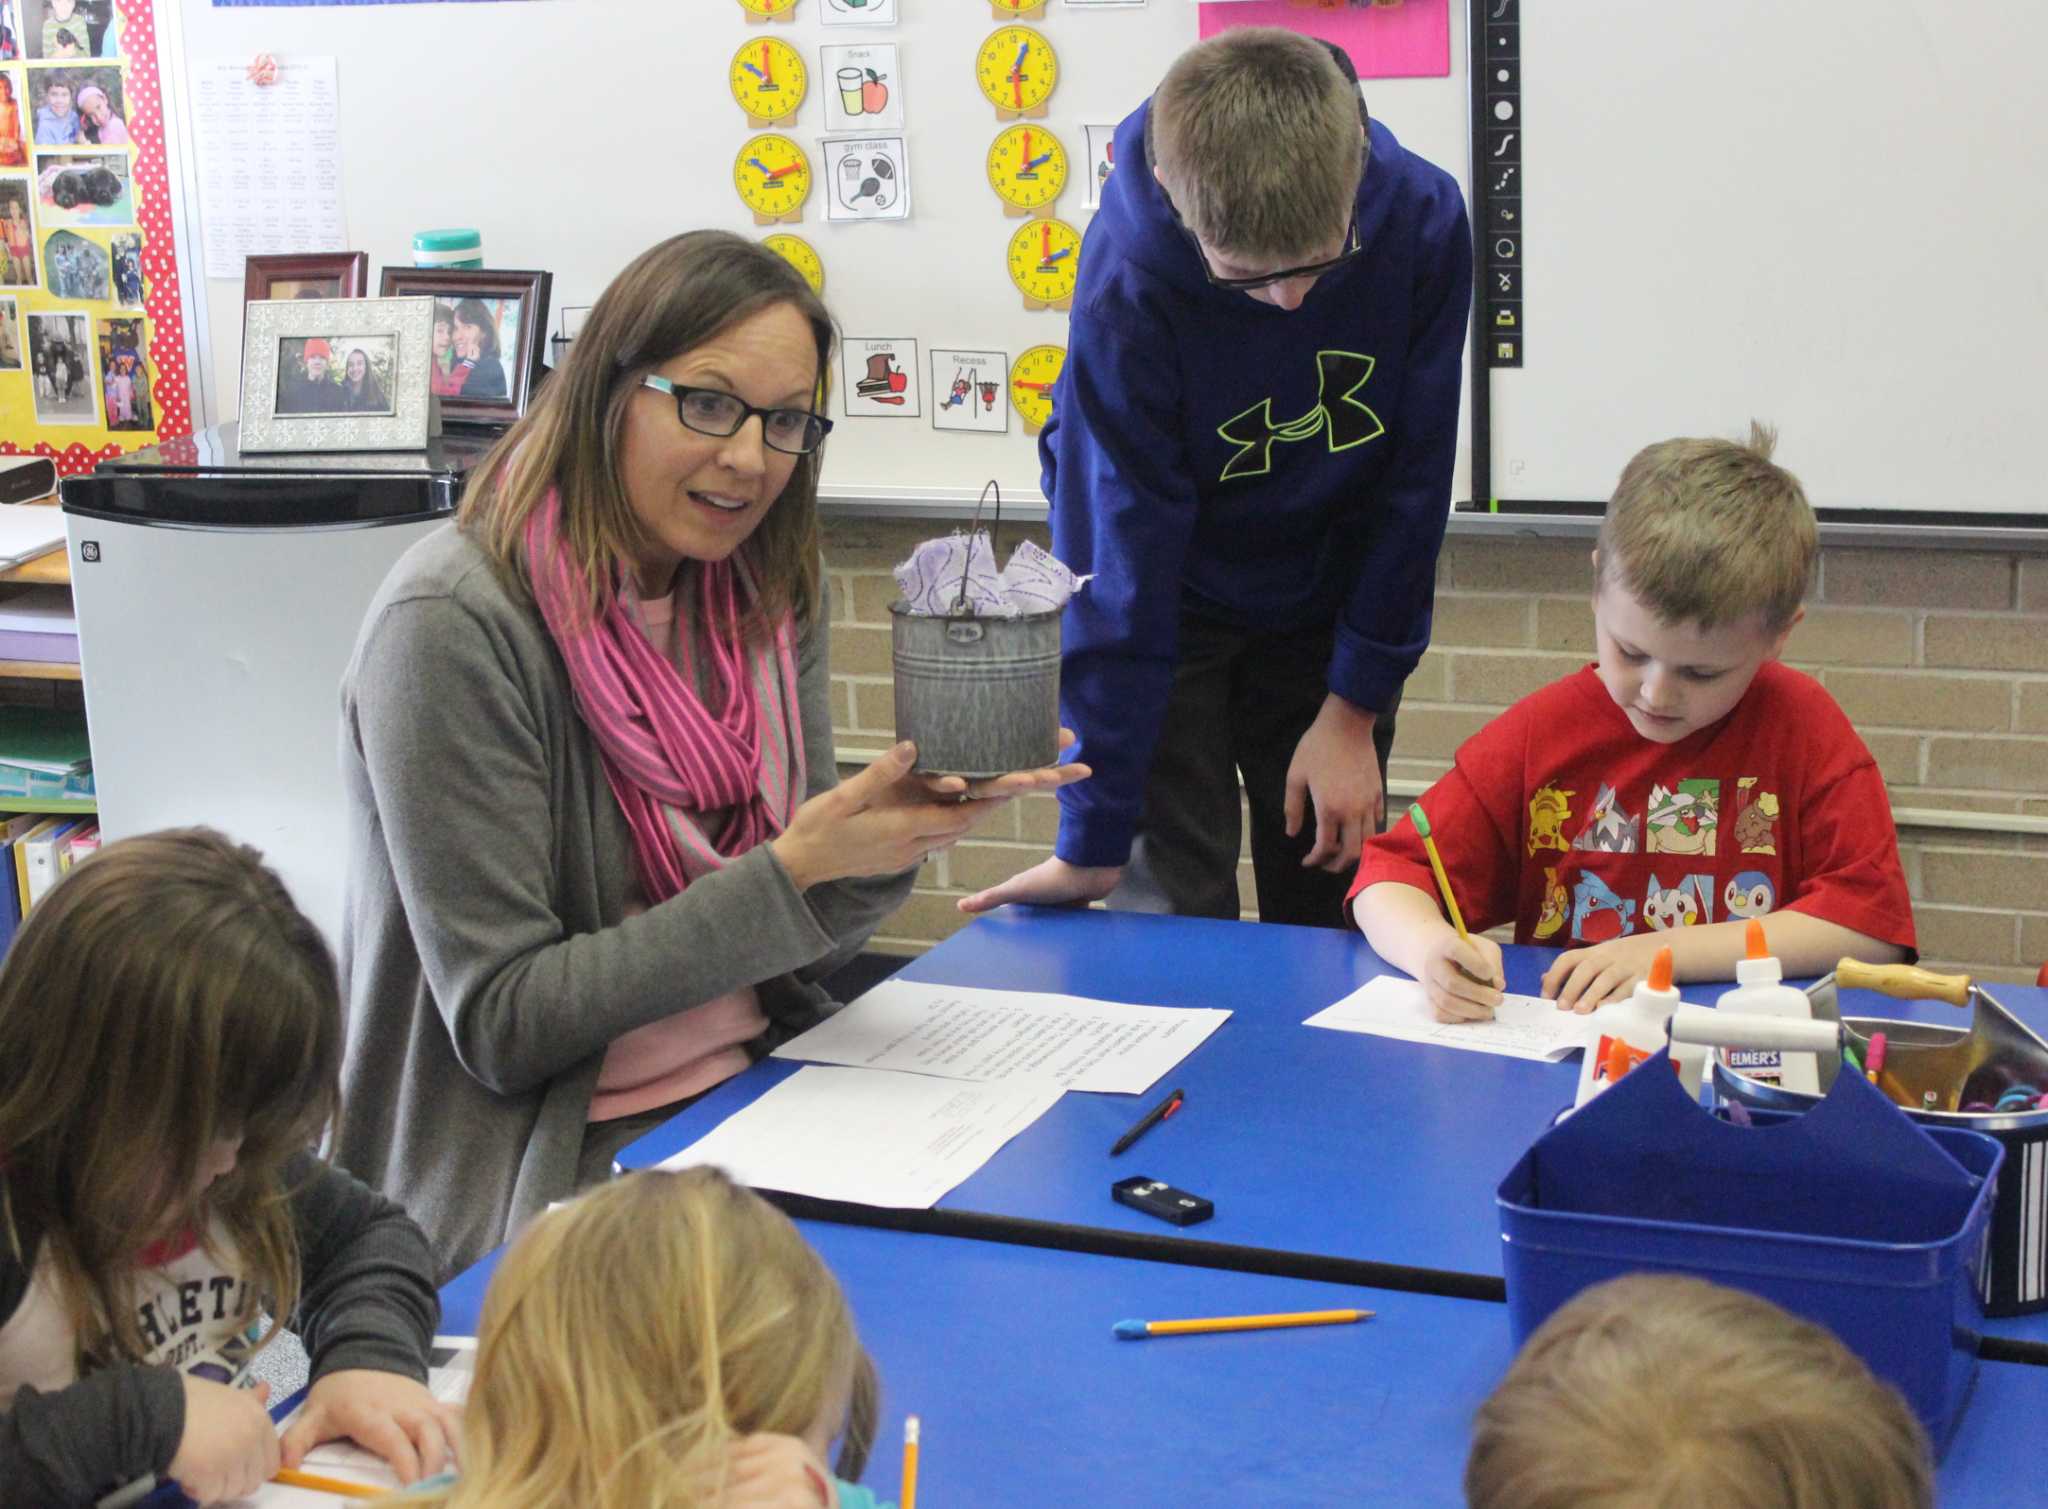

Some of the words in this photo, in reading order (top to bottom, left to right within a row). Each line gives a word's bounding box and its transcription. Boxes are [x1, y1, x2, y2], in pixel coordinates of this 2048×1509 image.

[865, 342, 892, 351] Lunch
[952, 354, 987, 366] Recess
[1730, 1050, 1779, 1067] ELMER'S
